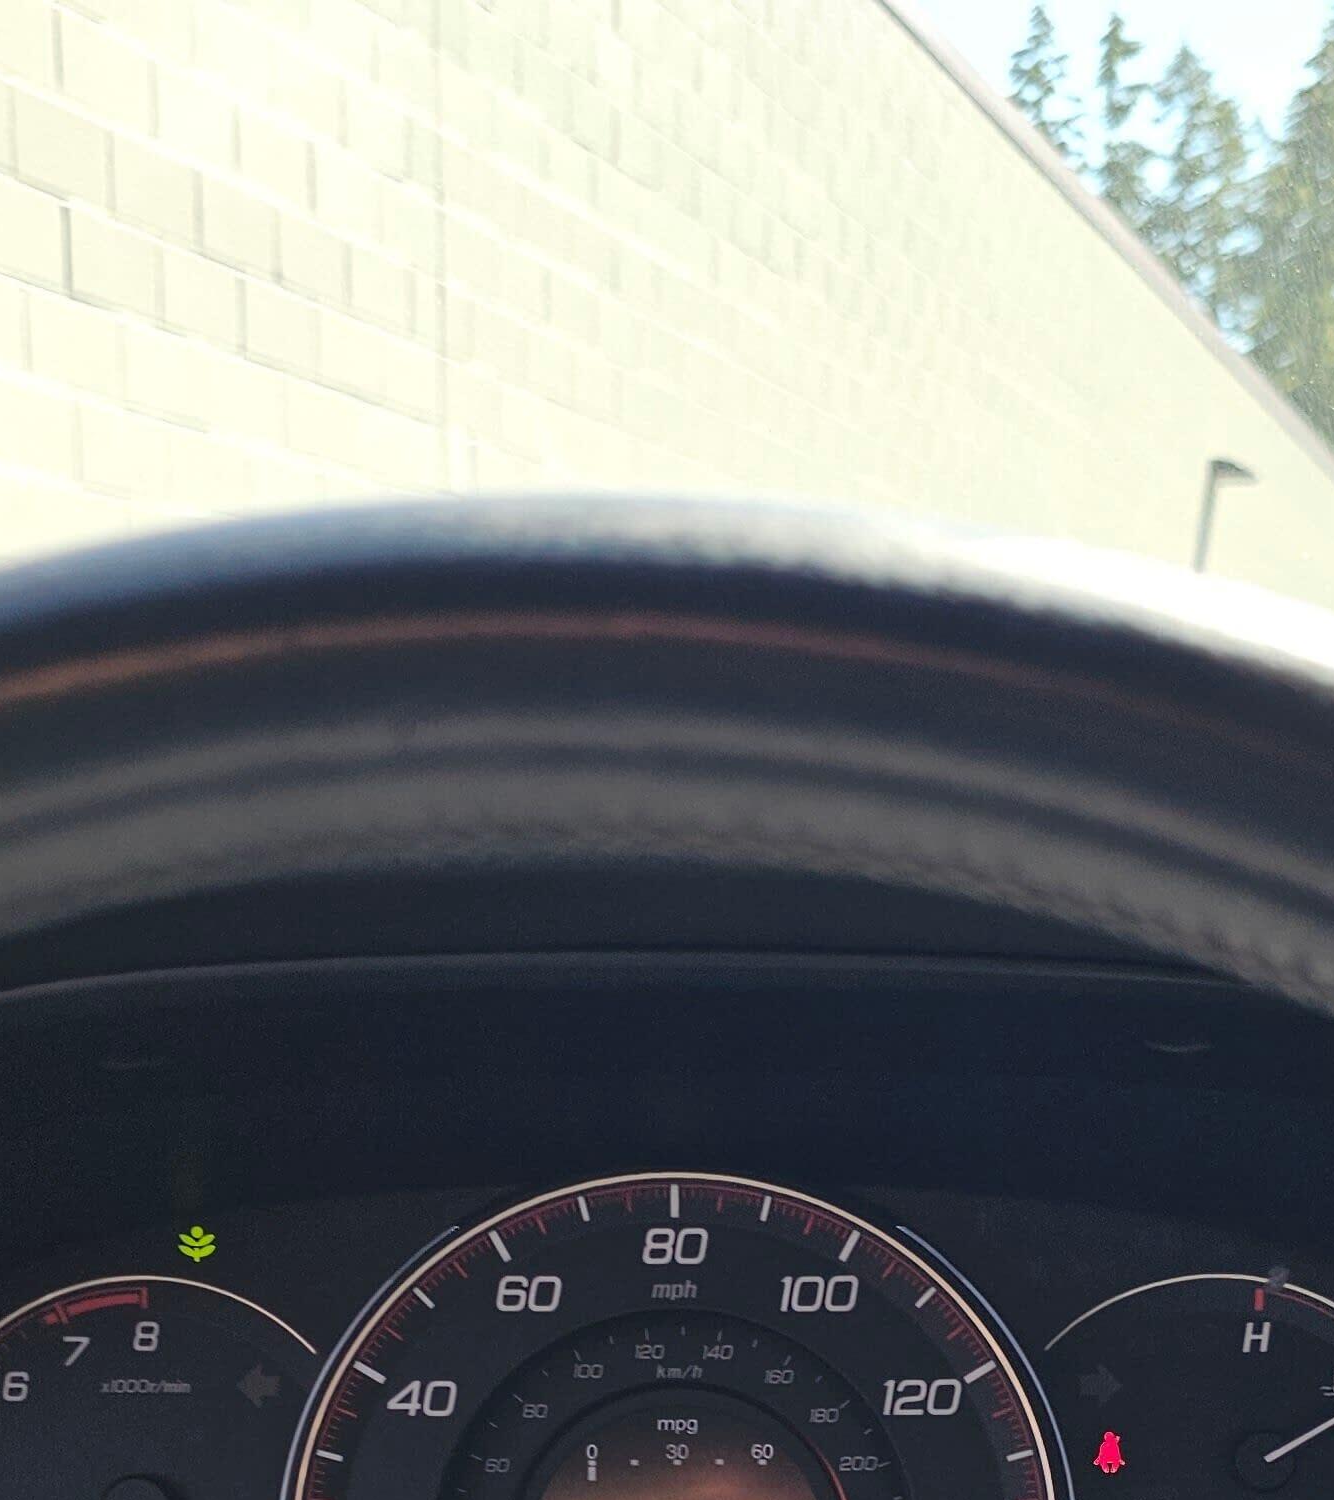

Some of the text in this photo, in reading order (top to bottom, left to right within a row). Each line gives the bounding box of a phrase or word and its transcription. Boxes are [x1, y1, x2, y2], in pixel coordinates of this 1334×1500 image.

[643, 1228, 708, 1264] 80
[497, 1276, 561, 1311] 60
[652, 1280, 697, 1300] mph
[781, 1275, 858, 1312] 100
[133, 1321, 159, 1351] 8
[1243, 1322, 1270, 1352] H
[63, 1336, 89, 1365] 7
[635, 1344, 664, 1359] 120
[703, 1345, 733, 1360] 140
[574, 1364, 603, 1378] 100
[657, 1365, 702, 1378] km/h
[765, 1370, 794, 1384] 160
[3, 1372, 29, 1401] 6
[386, 1380, 456, 1416] 40
[883, 1378, 961, 1415] 120
[810, 1408, 838, 1423] 180
[658, 1419, 698, 1434] mpg
[586, 1443, 774, 1459] 0 30 60
[485, 1457, 510, 1472] 60
[839, 1456, 872, 1471] 200
